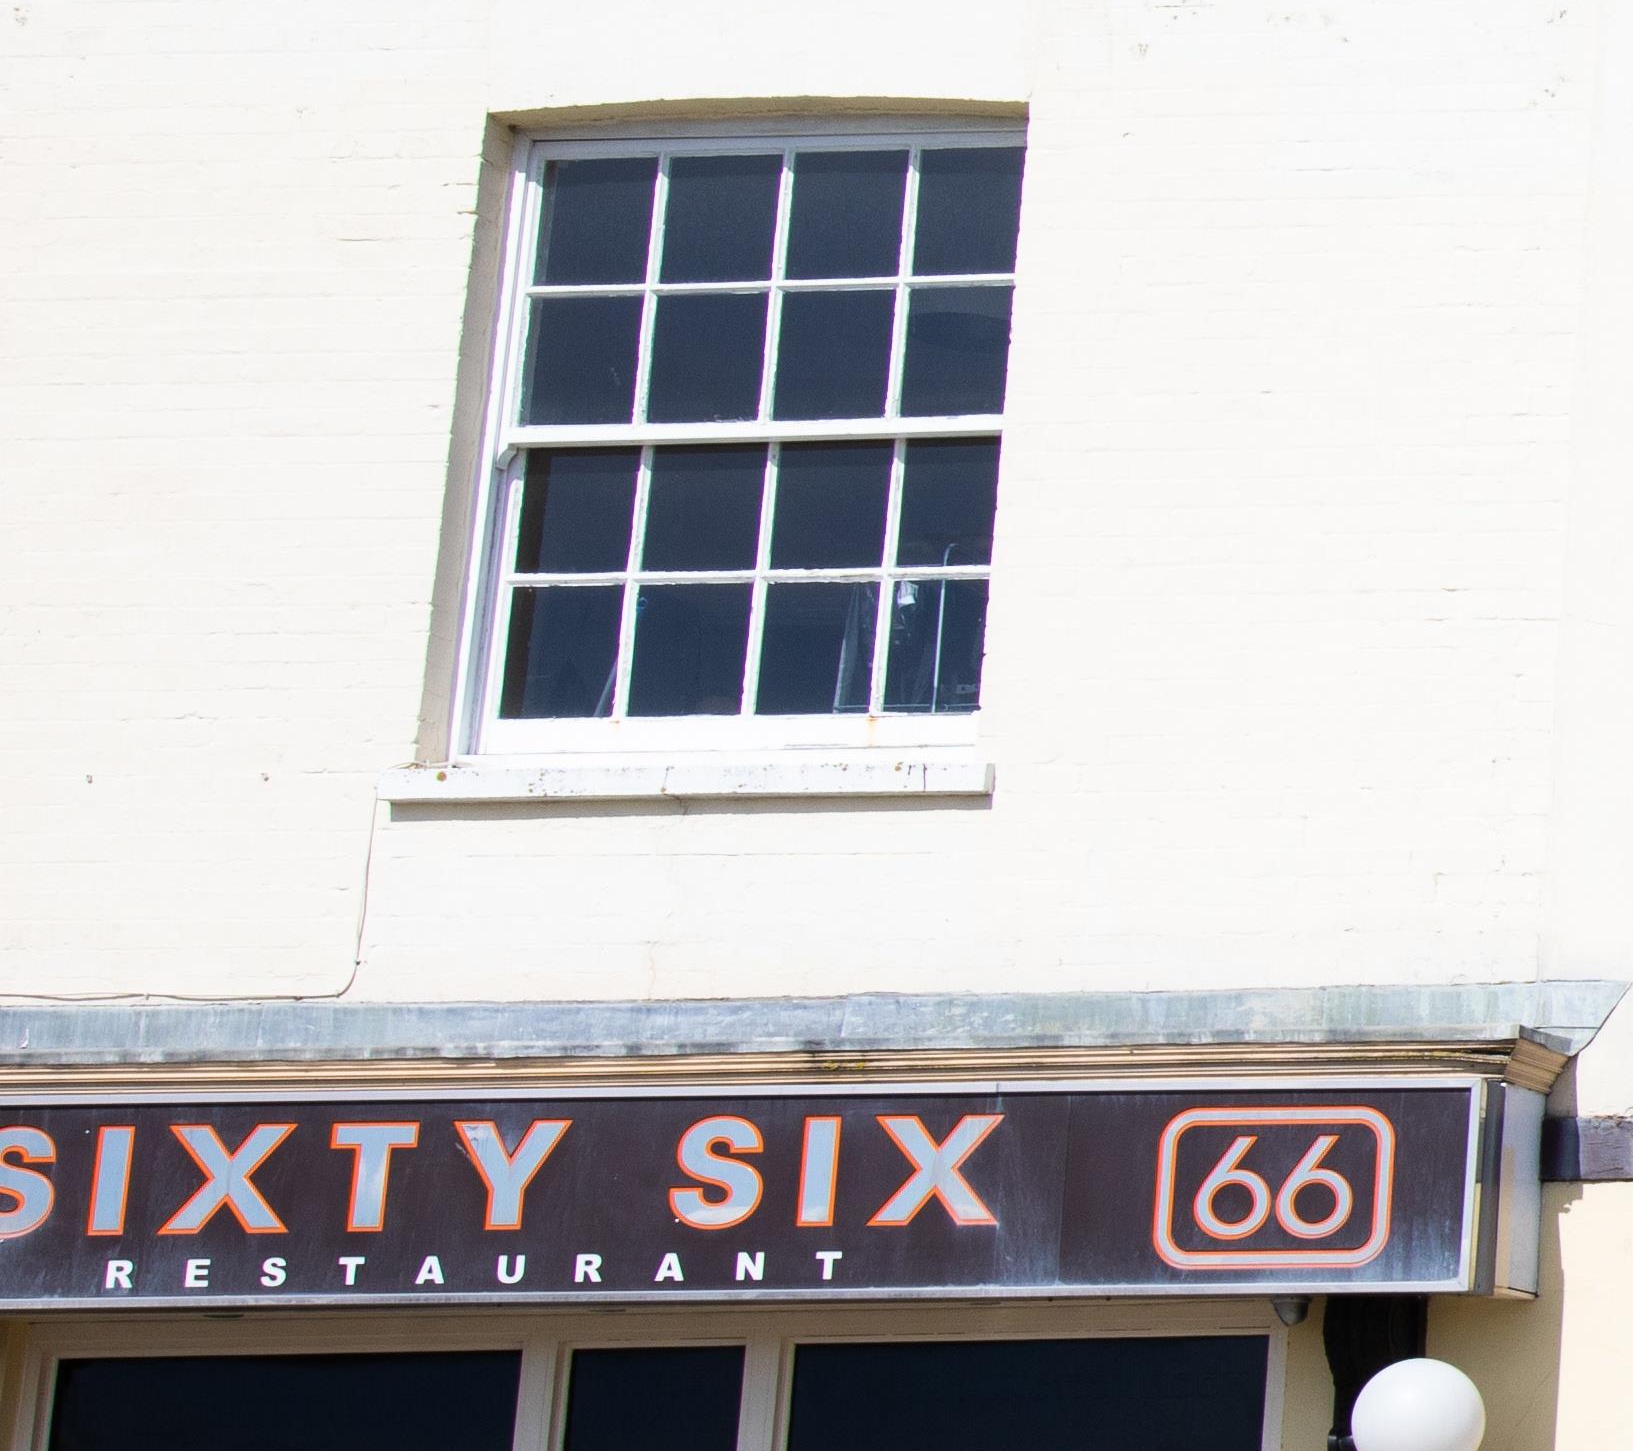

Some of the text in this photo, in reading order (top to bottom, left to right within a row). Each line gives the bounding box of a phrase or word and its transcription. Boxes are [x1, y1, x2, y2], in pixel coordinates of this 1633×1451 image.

[668, 1113, 1004, 1230] SIX
[1193, 1134, 1353, 1240] 66
[105, 1251, 843, 1289] RESTAURANT
